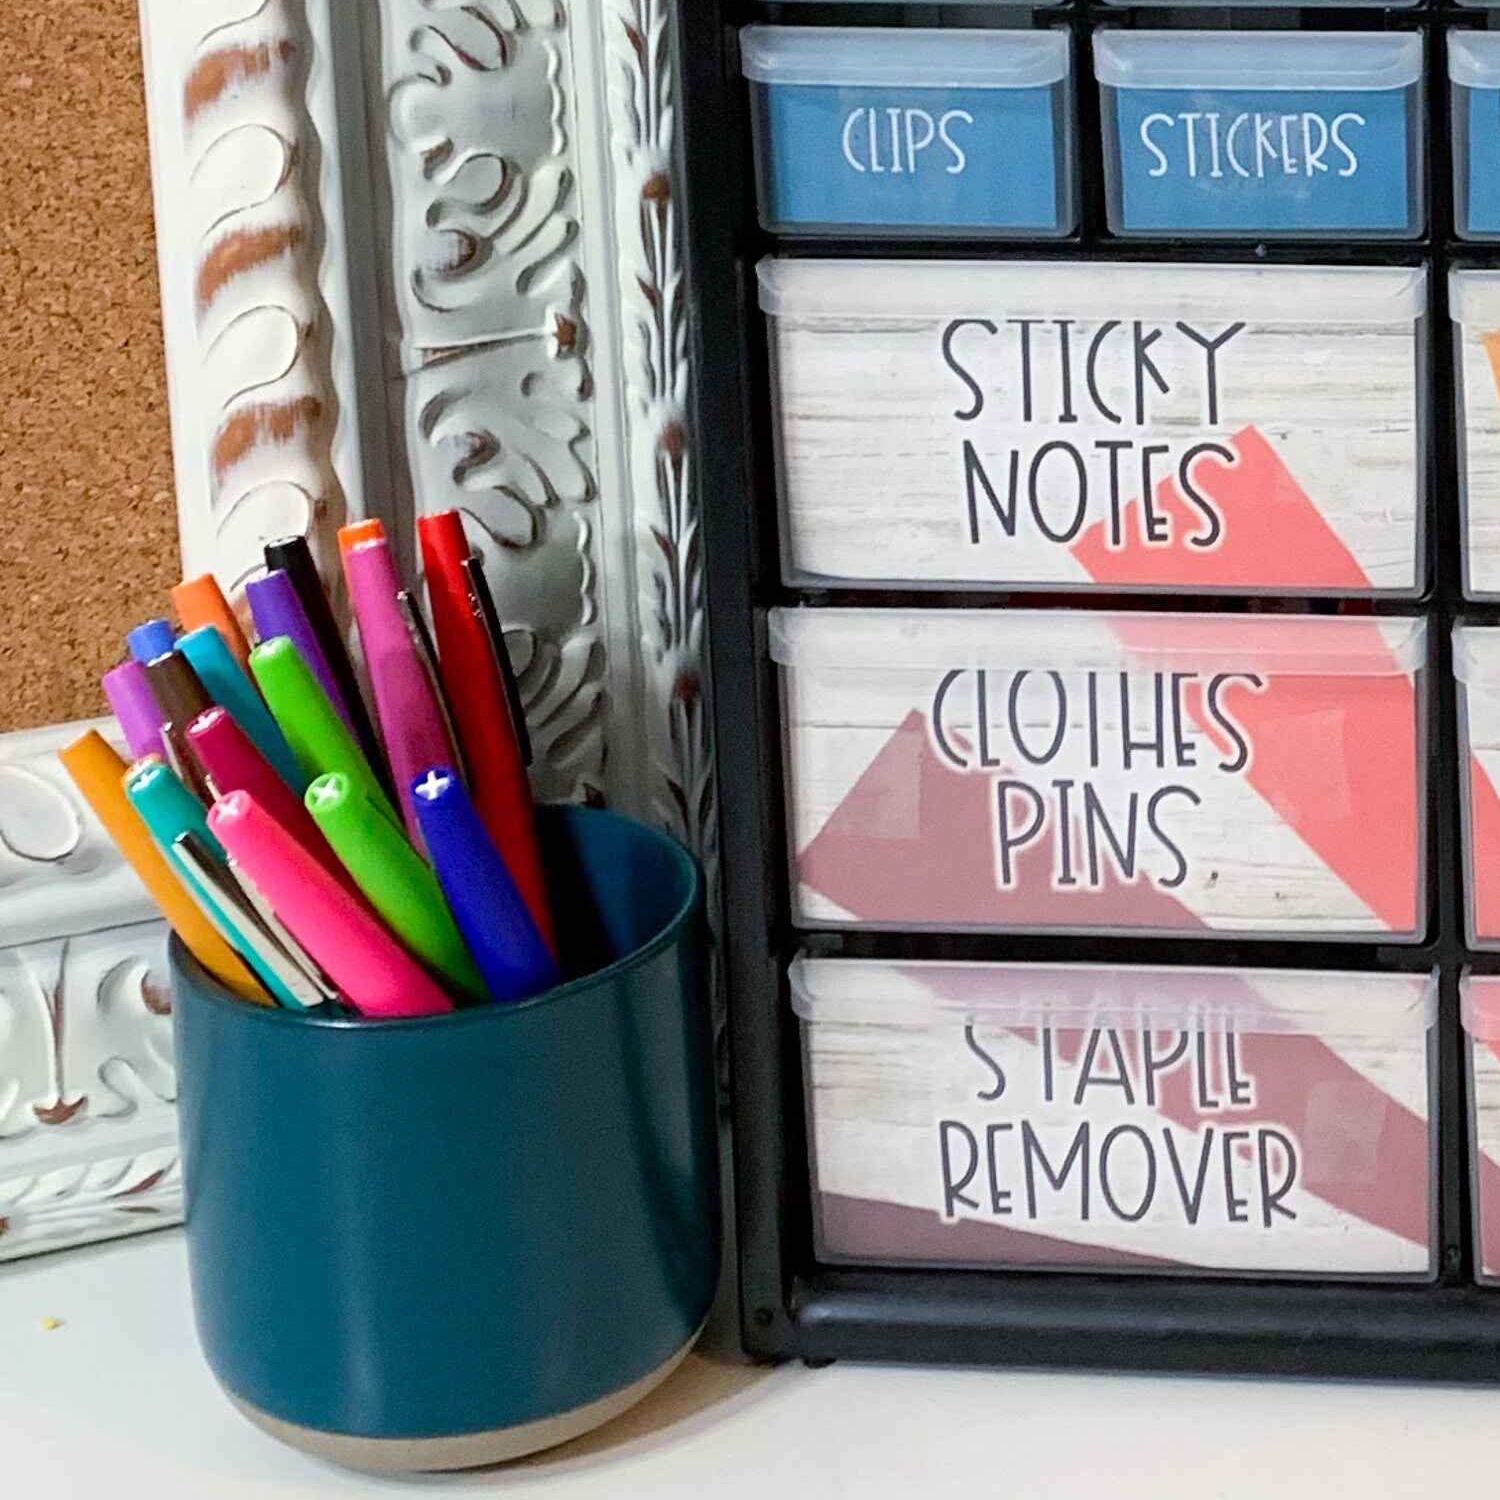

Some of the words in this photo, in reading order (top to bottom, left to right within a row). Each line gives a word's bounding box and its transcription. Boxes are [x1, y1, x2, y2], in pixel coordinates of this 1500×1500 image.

[842, 108, 973, 175] CLIPS
[1140, 112, 1365, 178] STICKERS
[942, 318, 1246, 425] STICKY
[963, 439, 1237, 547] NOTES
[931, 667, 1263, 772] CLOTHES
[998, 778, 1201, 888] PINS
[964, 997, 1252, 1108] STAPLE
[940, 1119, 1297, 1228] REMOVER
